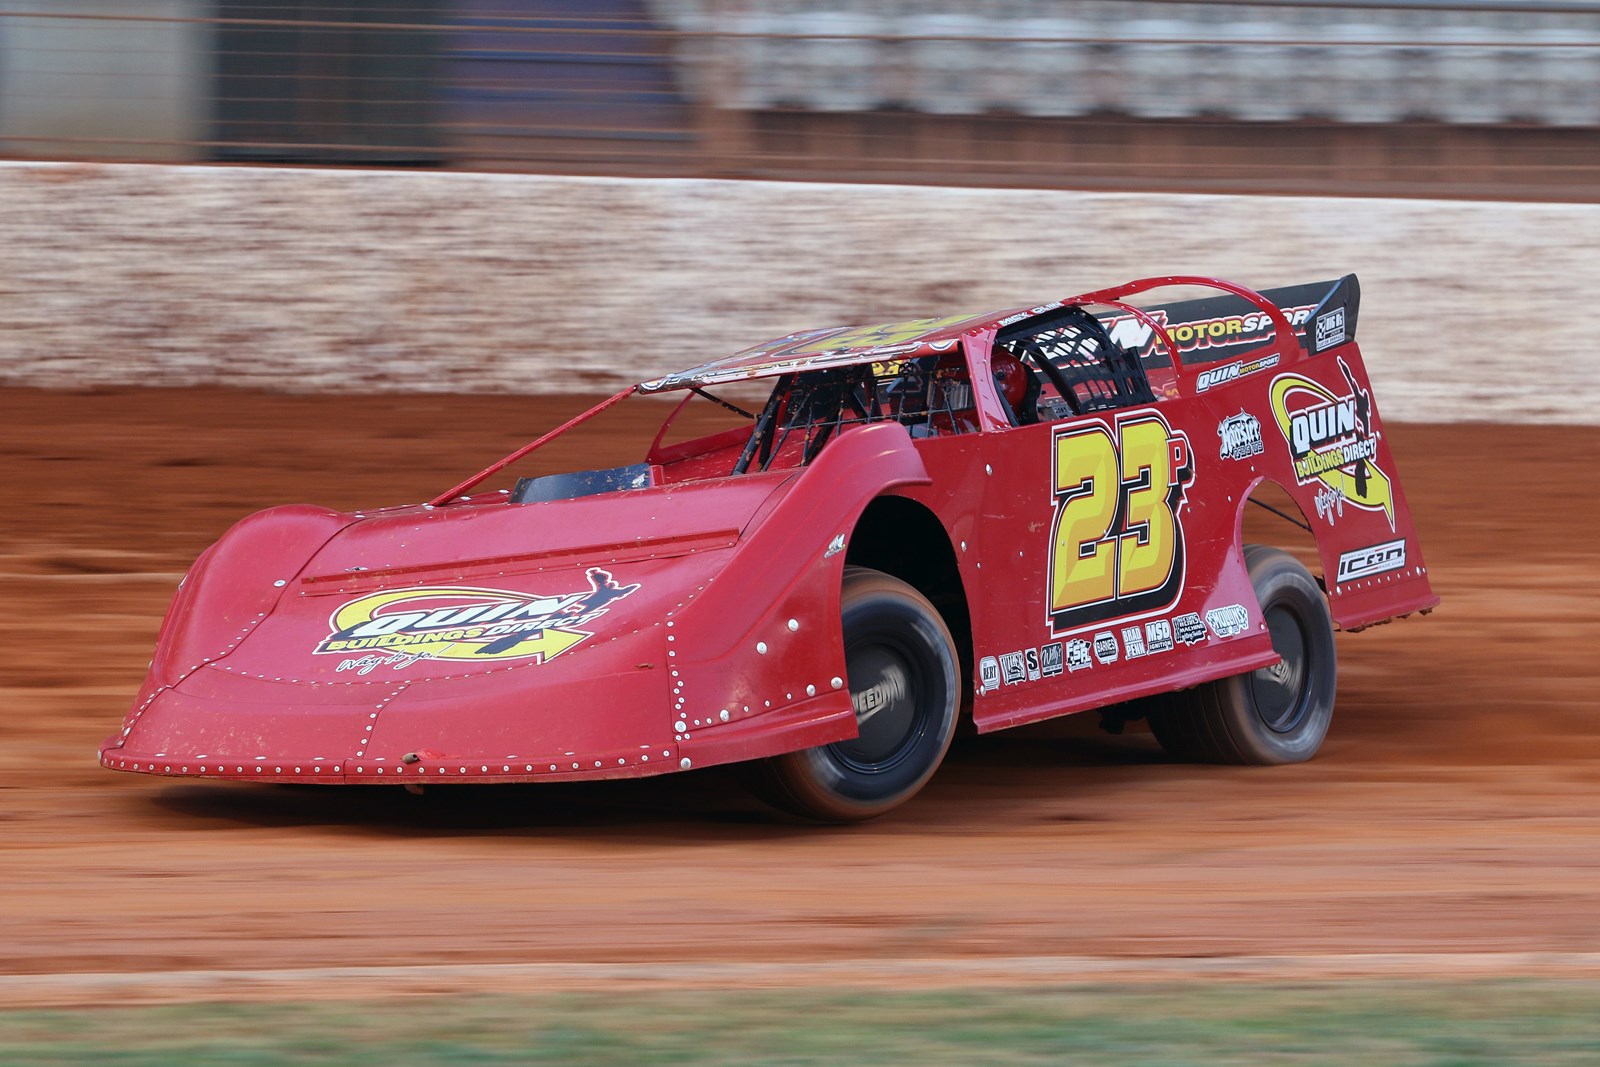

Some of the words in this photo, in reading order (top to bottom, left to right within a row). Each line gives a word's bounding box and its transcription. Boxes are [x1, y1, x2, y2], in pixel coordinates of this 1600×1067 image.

[1030, 301, 1064, 314] QUIN
[1156, 306, 1315, 345] MOTORSPR
[1198, 362, 1241, 391] QUIN
[1291, 400, 1356, 454] QUIN
[1296, 447, 1344, 478] BUILDINGS
[1342, 437, 1376, 464] DIRECT
[349, 594, 587, 638] QUIN
[326, 626, 485, 651] BUILDINGS
[482, 613, 602, 637] DIRECT
[1121, 627, 1142, 643] BRAD
[1146, 621, 1170, 642] MSD
[1096, 638, 1116, 654] BARNES
[1125, 641, 1146, 659] PENN
[336, 652, 384, 675] Way
[983, 665, 998, 680] BERT
